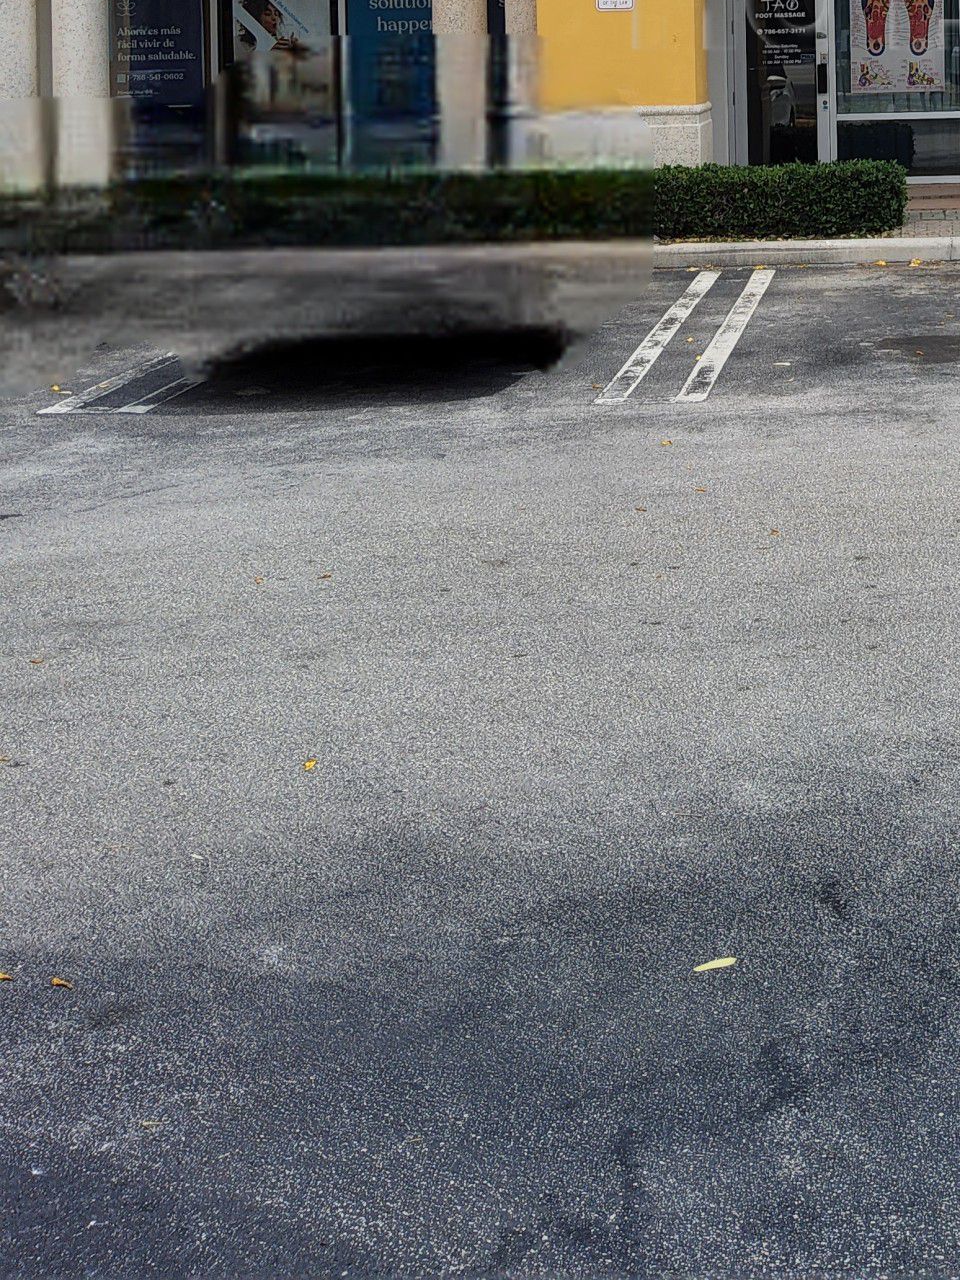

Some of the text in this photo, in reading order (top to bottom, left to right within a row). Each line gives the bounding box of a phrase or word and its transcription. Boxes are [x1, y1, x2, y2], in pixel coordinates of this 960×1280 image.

[160, 25, 181, 35] más
[139, 39, 161, 48] vivir
[163, 39, 175, 48] de
[117, 50, 196, 62] forma saludable.
